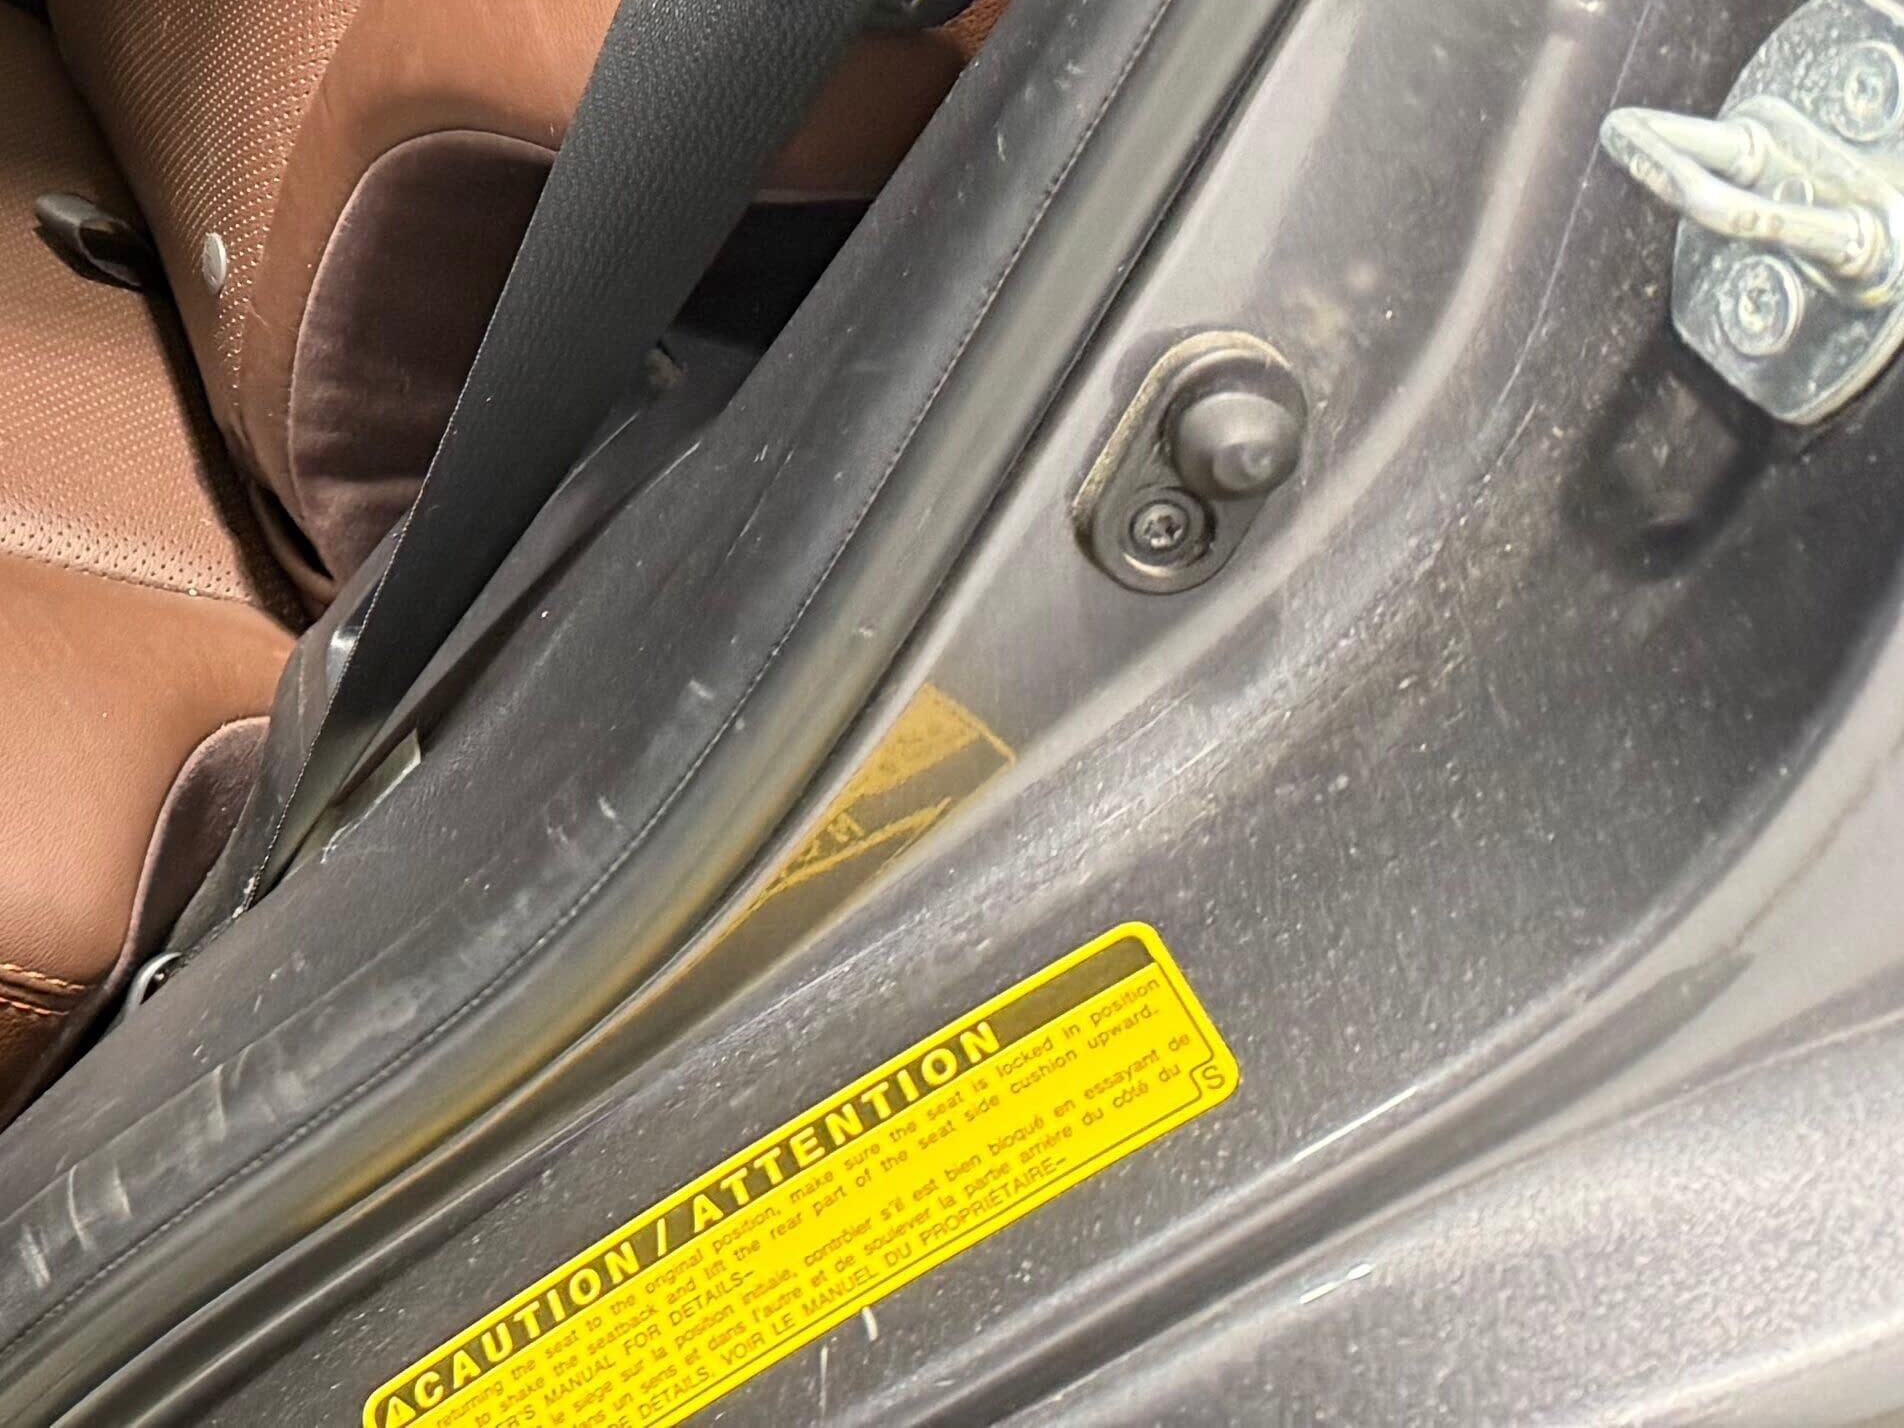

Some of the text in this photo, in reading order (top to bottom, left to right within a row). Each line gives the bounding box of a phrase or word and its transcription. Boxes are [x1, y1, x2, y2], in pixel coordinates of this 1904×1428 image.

[414, 1241, 640, 1409] CAUTION
[693, 1020, 1001, 1233] ATTENTION
[473, 1410, 492, 1425] to
[497, 1375, 545, 1412] shake
[551, 1353, 579, 1377] the
[585, 1303, 659, 1356] seatback
[664, 1276, 697, 1305] and
[702, 1258, 727, 1280] lift
[732, 1238, 761, 1261] the
[768, 1211, 803, 1240] rear
[811, 1184, 847, 1216] part
[854, 1167, 872, 1188] of
[879, 1148, 909, 1172] the
[916, 1119, 956, 1150] seat
[962, 1093, 1000, 1122] side
[1009, 1048, 1078, 1095] cushion
[508, 1357, 537, 1381] the
[543, 1328, 580, 1359] seat
[584, 1314, 603, 1332] to
[608, 1292, 637, 1316] the
[643, 1247, 705, 1295] original
[710, 1205, 781, 1254] position,
[788, 1169, 834, 1204] make
[842, 1142, 881, 1171] sure
[888, 1119, 918, 1143] the
[925, 1090, 964, 1121] seat
[970, 1076, 989, 1094] is
[995, 1035, 1054, 1078] locked
[1061, 1022, 1081, 1040] in
[1089, 977, 1160, 1027] position
[548, 1409, 566, 1424] le
[618, 1358, 645, 1383] sur
[649, 1345, 668, 1362] la
[672, 1303, 735, 1350] position
[911, 1177, 939, 1202] est
[943, 1153, 982, 1182] bien
[1052, 1098, 1076, 1118] en
[1083, 1048, 1160, 1101] essayant
[1166, 1032, 1191, 1052] de
[611, 1391, 634, 1412] un
[638, 1363, 678, 1394] sens
[682, 1347, 701, 1366] et
[706, 1319, 746, 1351] dans
[750, 1285, 803, 1323] l'autre
[808, 1269, 828, 1288] et
[833, 1252, 856, 1273] de
[862, 1206, 932, 1256] soulever
[937, 1193, 957, 1210] la
[961, 1160, 1011, 1199] partie
[1080, 1106, 1104, 1126] du
[1157, 1062, 1181, 1083] du
[1199, 1063, 1226, 1090] S
[542, 1354, 616, 1407] MANUAL
[621, 1323, 662, 1356] FOR
[719, 1330, 766, 1365] VOIR
[769, 1311, 796, 1336] LE
[800, 1264, 879, 1316] MANUEL
[882, 1241, 913, 1267] DU
